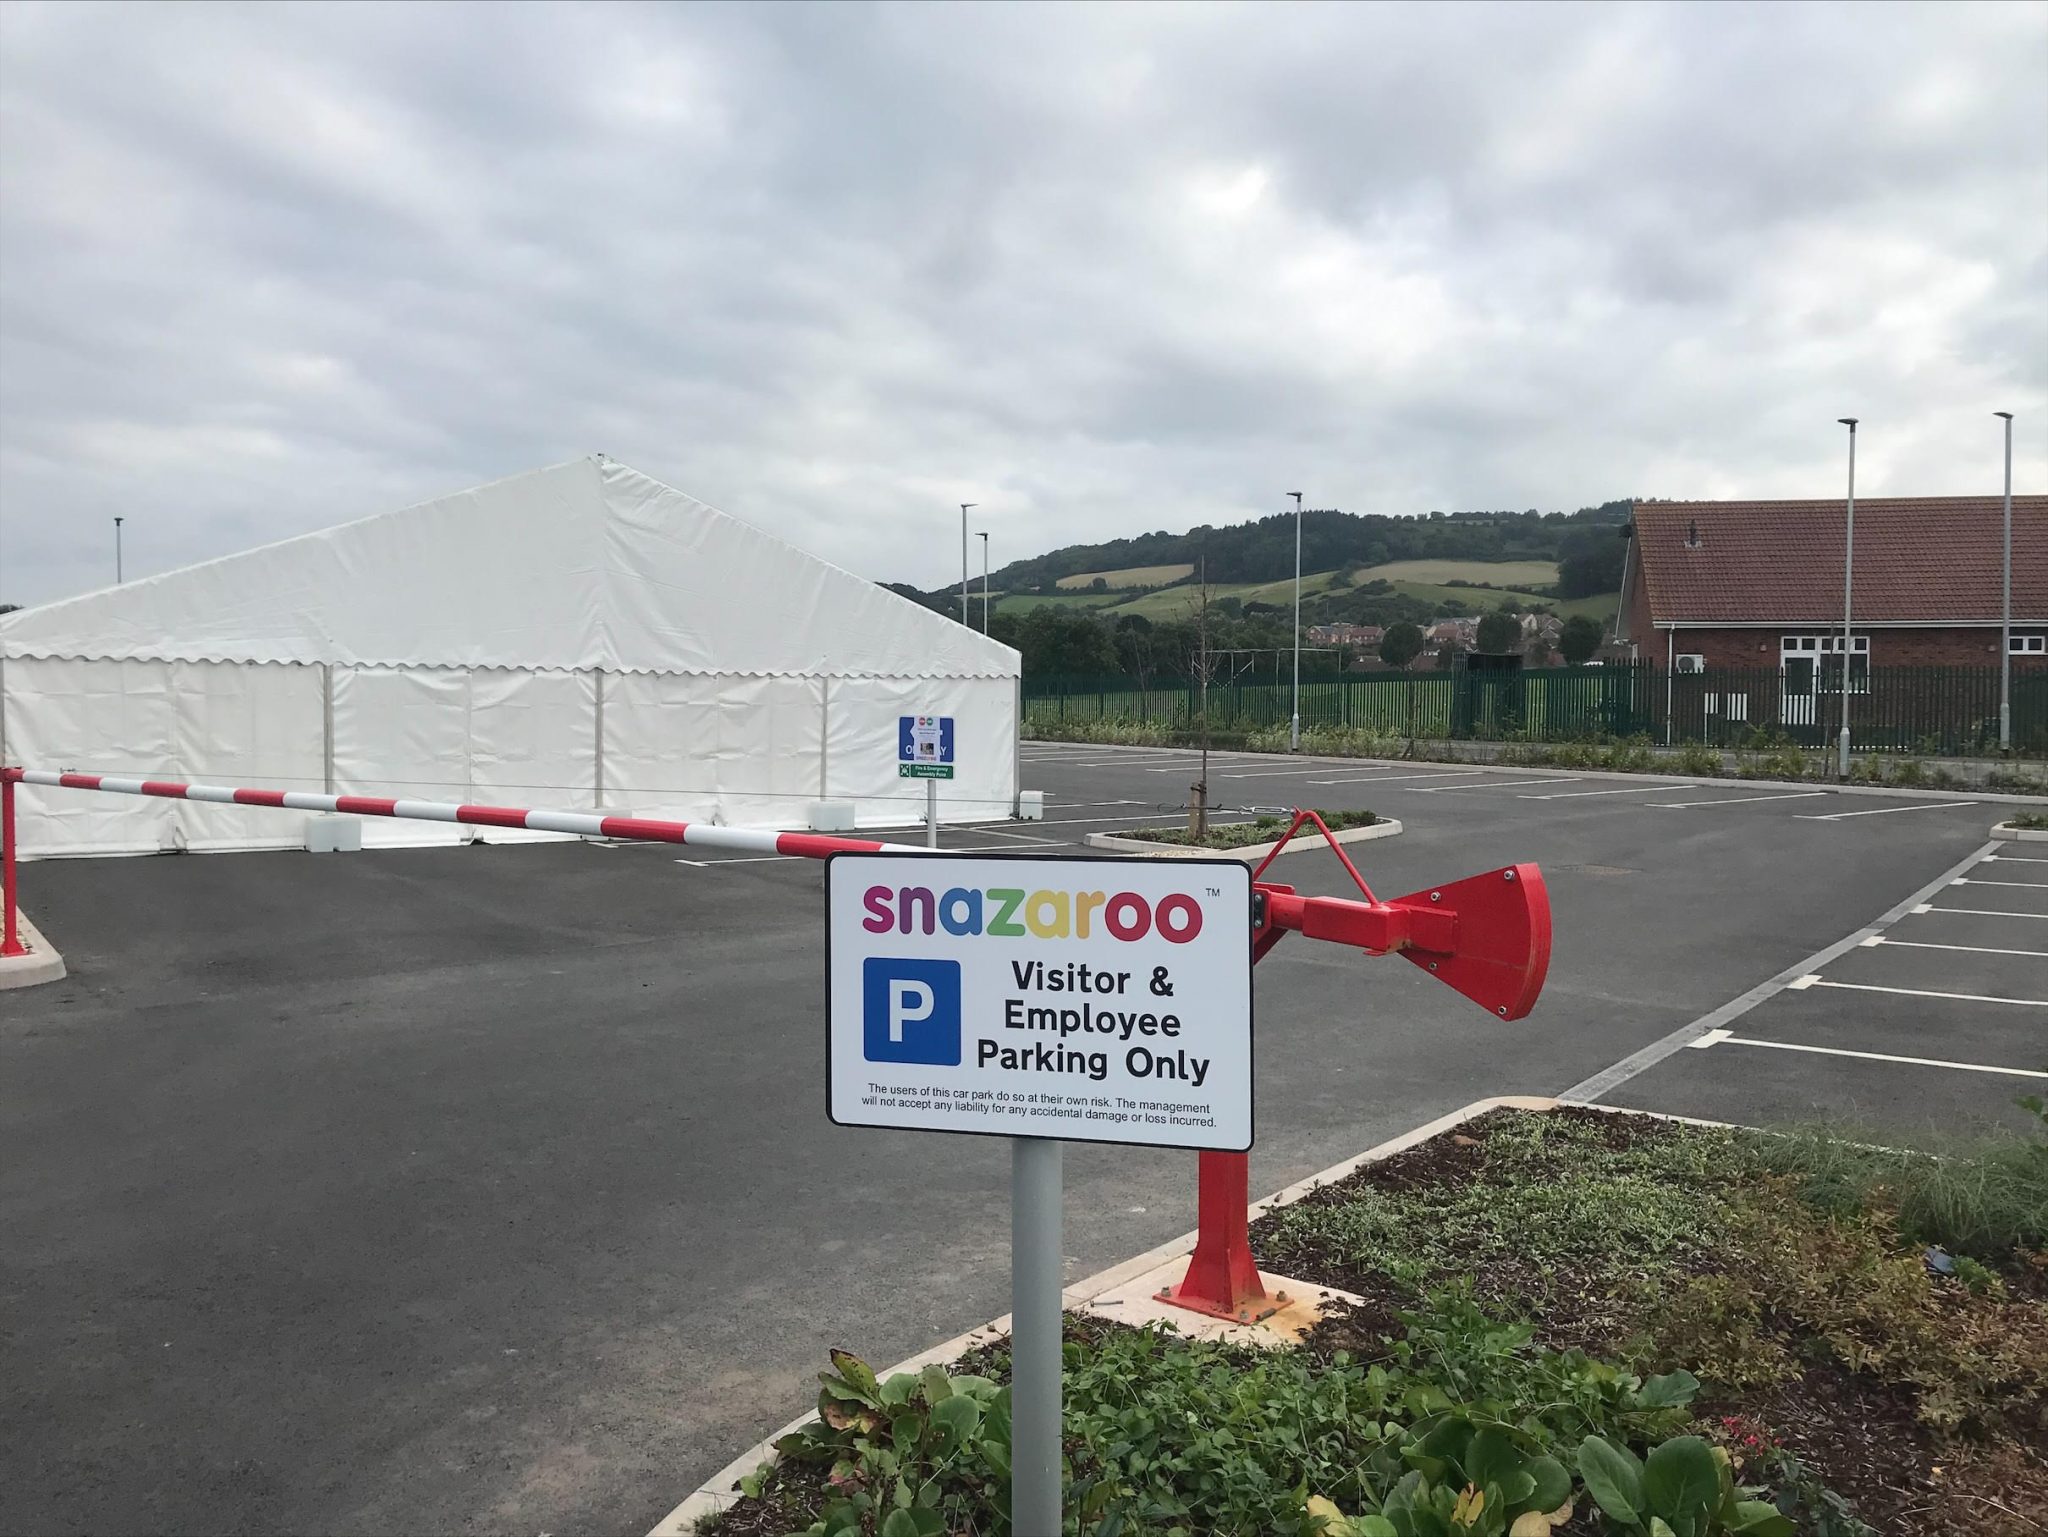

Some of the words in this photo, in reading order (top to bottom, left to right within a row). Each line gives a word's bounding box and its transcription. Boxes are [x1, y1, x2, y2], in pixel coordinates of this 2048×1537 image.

[862, 885, 1203, 944] snazaroo
[1012, 961, 1131, 995] Visitor
[1149, 966, 1174, 997] &
[889, 979, 935, 1042] P
[1005, 1000, 1181, 1040] Employee
[978, 1040, 1108, 1080] Parking
[1126, 1047, 1210, 1087] Only
[861, 1096, 878, 1107] will
[880, 1098, 896, 1108] not
[898, 1099, 932, 1110] accept
[934, 1102, 953, 1114] any
[955, 1101, 990, 1114] liability
[992, 1103, 1006, 1114] for
[1008, 1106, 1028, 1117] any
[1030, 1106, 1083, 1118] accidental
[1085, 1110, 1128, 1122] damage
[1130, 1114, 1143, 1122] or
[1145, 1113, 1167, 1124] loss
[1169, 1114, 1217, 1127] incurred.
[868, 1083, 887, 1094] The
[890, 1086, 917, 1096] users
[920, 1087, 930, 1097] of
[932, 1087, 950, 1098] this
[953, 1090, 970, 1099] car
[971, 1089, 994, 1100] park
[996, 1091, 1010, 1101] do
[1012, 1093, 1025, 1103] so
[1027, 1094, 1038, 1103] at
[1040, 1093, 1063, 1105] their
[1066, 1097, 1088, 1106] own
[1091, 1096, 1113, 1107] risk.
[1115, 1097, 1136, 1109] The
[1139, 1101, 1211, 1114] management
